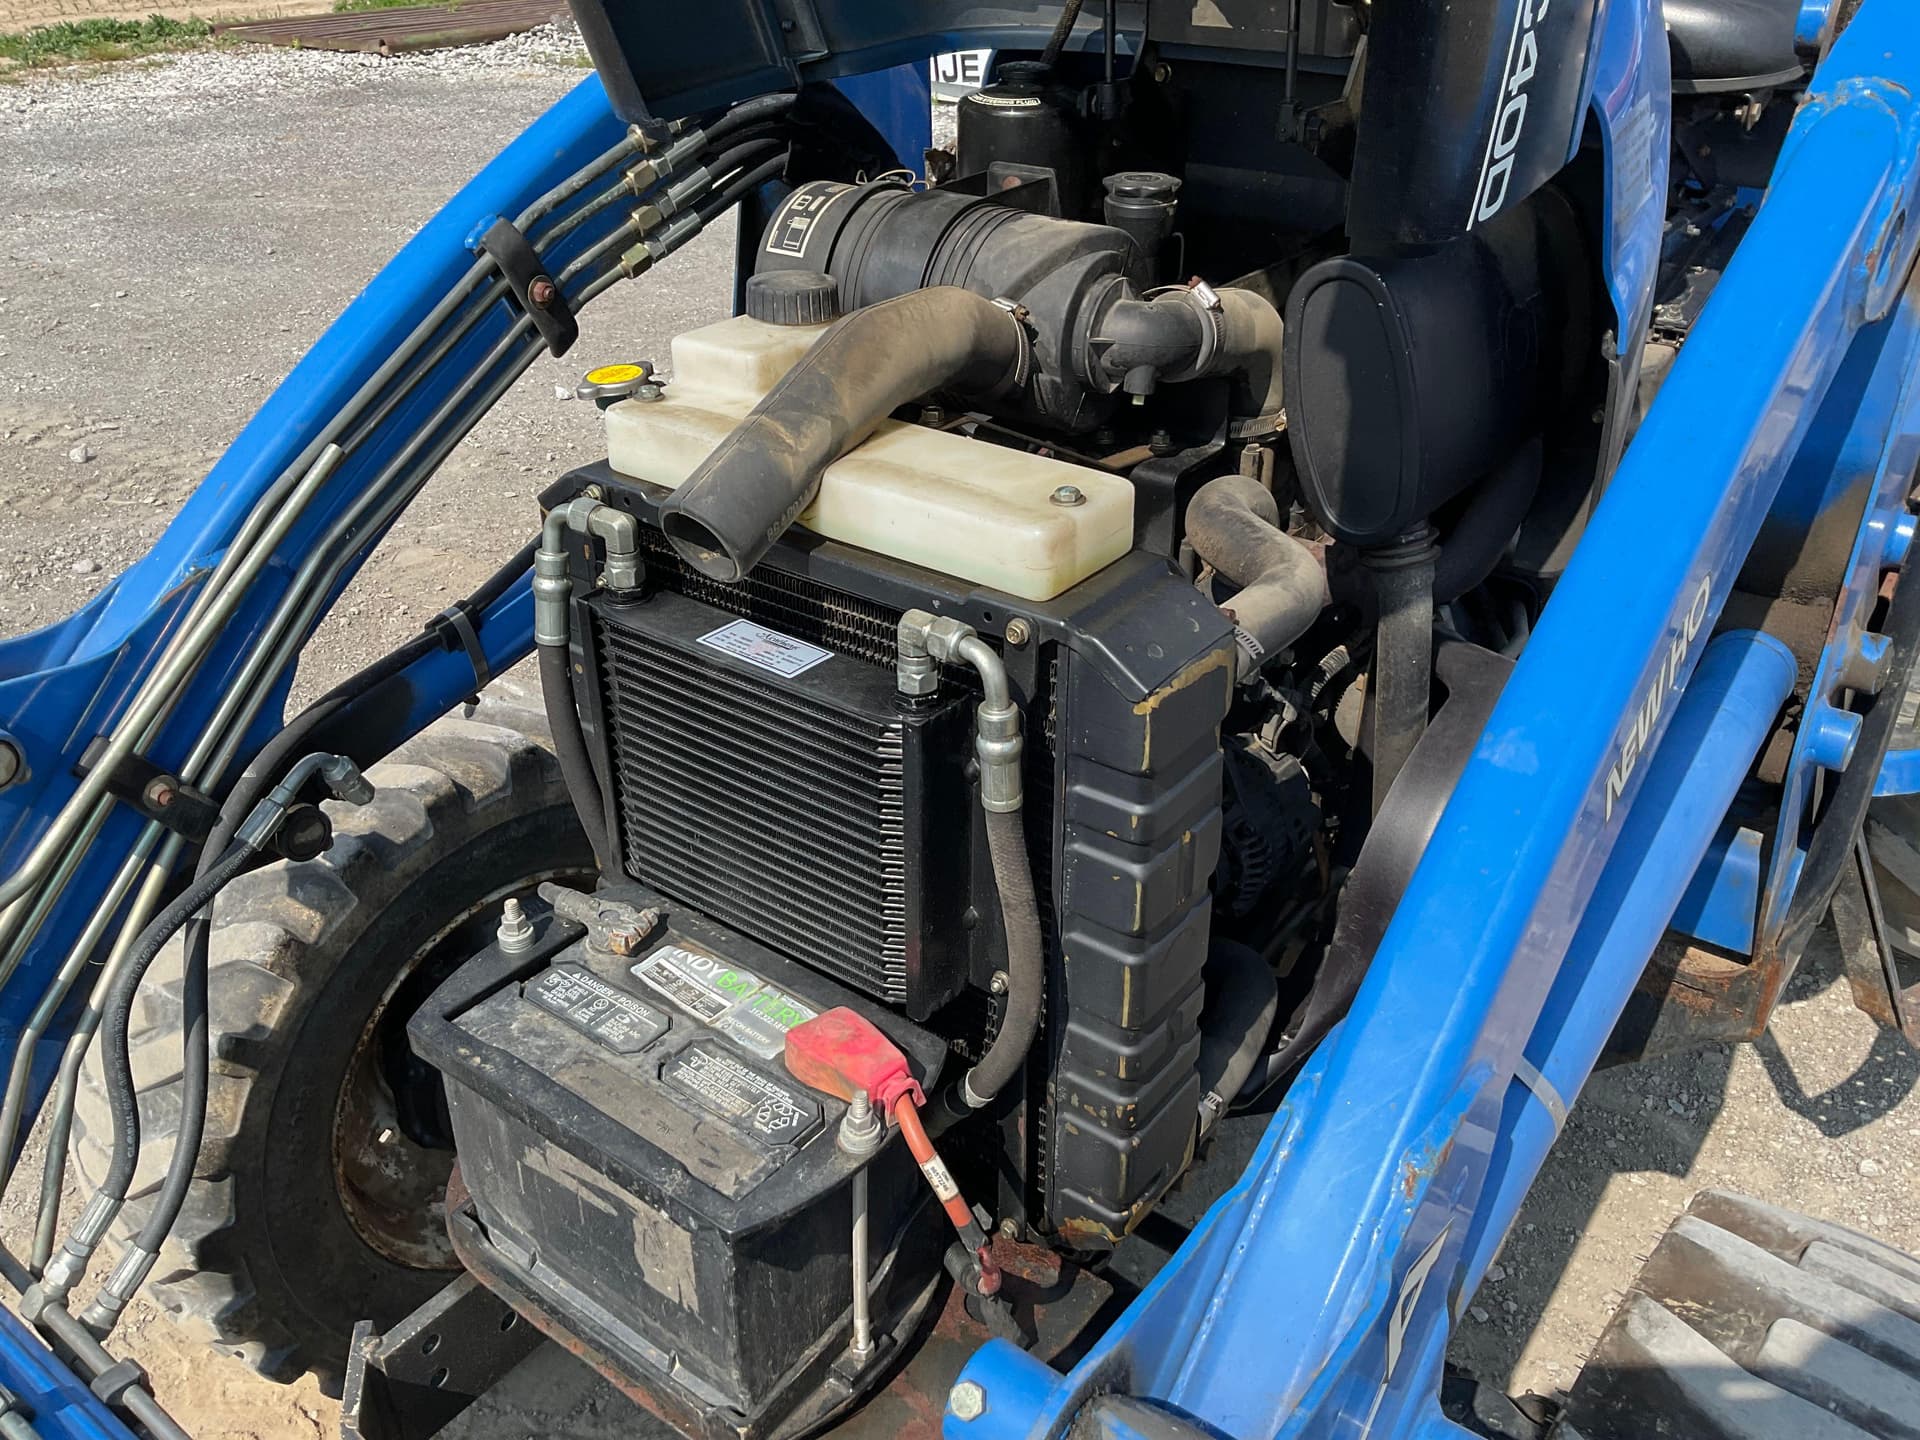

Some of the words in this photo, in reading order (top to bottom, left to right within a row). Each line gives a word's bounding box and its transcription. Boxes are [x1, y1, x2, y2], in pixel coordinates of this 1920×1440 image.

[1604, 654, 1668, 823] NEW
[580, 975, 614, 997] DANGER
[619, 996, 651, 1018] POISON
